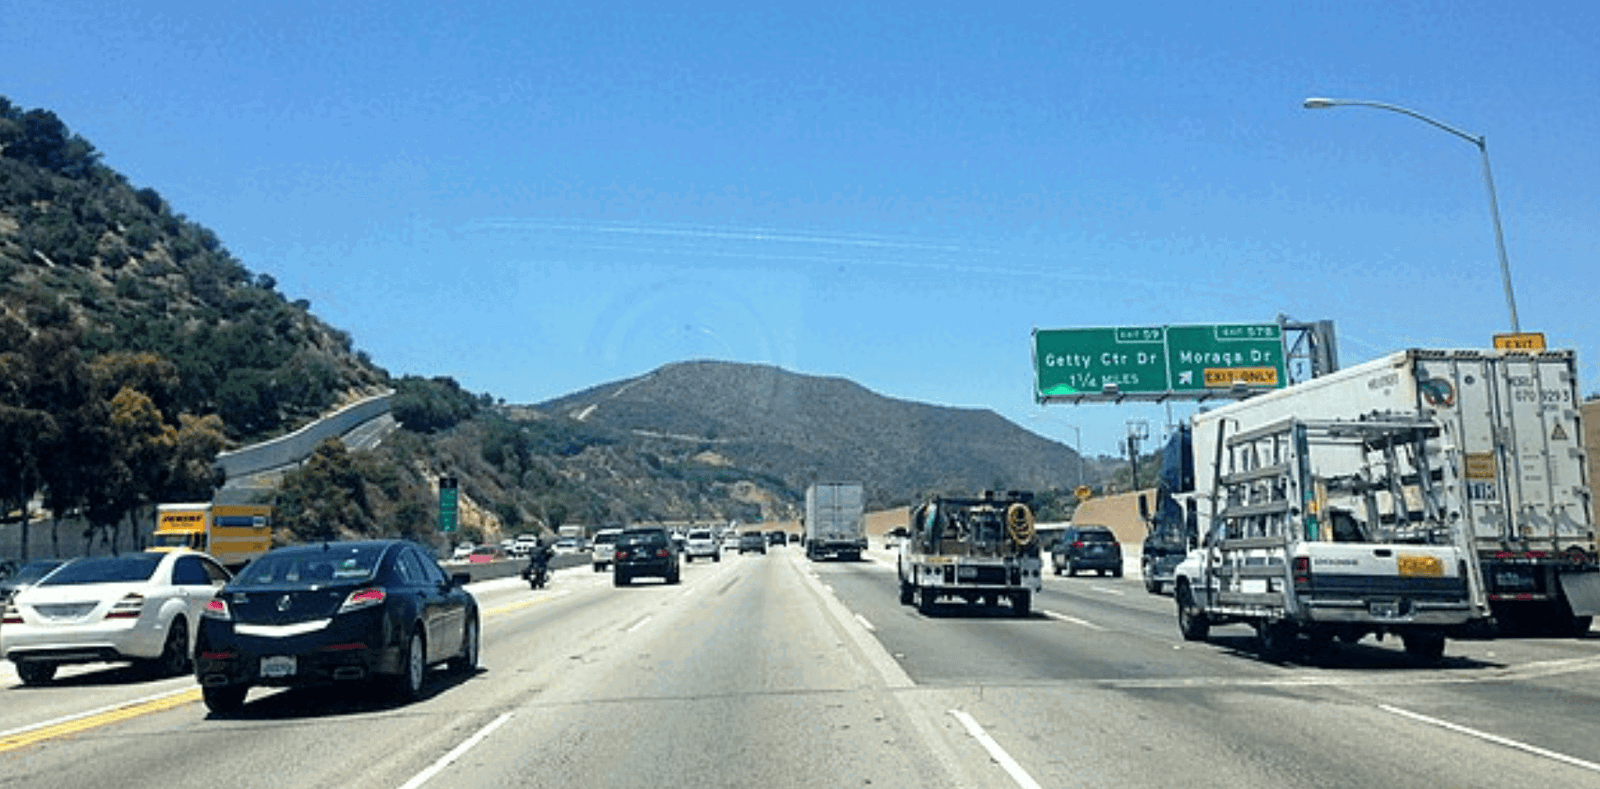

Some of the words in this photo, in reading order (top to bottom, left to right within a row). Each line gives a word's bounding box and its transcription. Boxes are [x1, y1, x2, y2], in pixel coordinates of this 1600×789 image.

[1045, 353, 1091, 369] Getty
[1101, 352, 1127, 367] Ctr
[1137, 352, 1157, 365] Dr
[1180, 350, 1244, 367] Moraga
[1250, 349, 1272, 363] Dr
[1102, 373, 1139, 385] MILES
[1206, 369, 1234, 383] EXIT
[1241, 367, 1274, 382] ONLY
